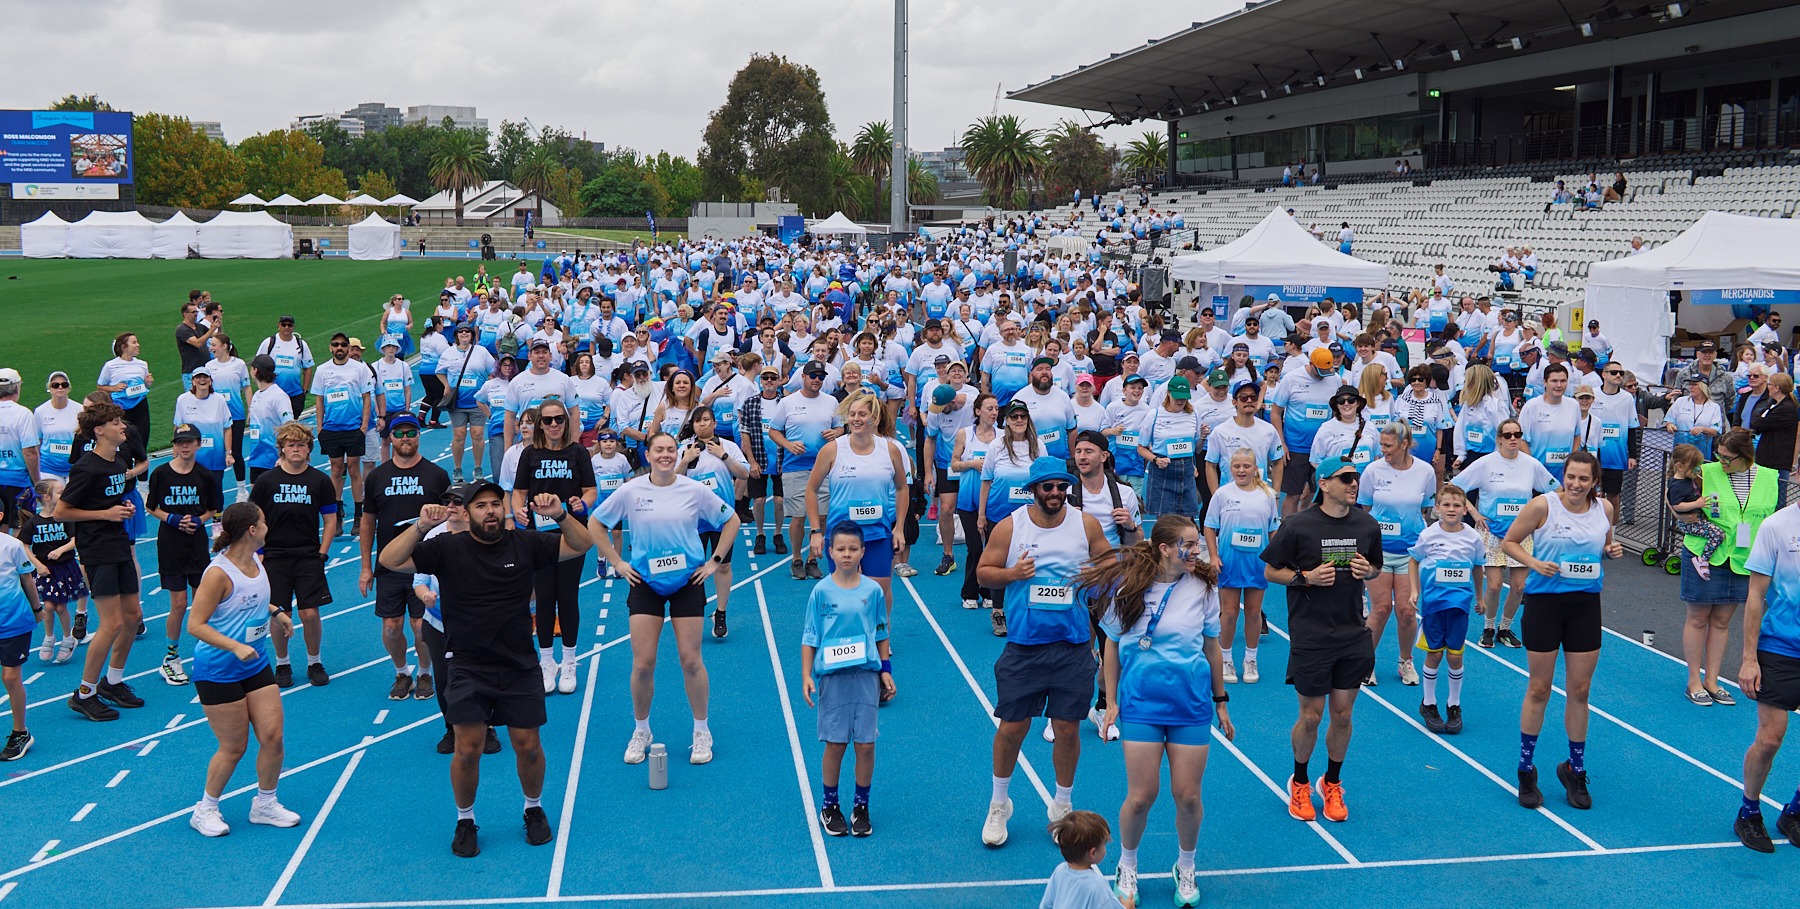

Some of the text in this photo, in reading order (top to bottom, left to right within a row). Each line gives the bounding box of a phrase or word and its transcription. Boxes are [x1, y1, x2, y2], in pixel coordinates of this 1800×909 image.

[1283, 285, 1326, 294] PHOTO BOOTH
[1722, 289, 1775, 298] MERCHANDISE
[541, 460, 567, 469] TEAM
[535, 469, 572, 479] GLAMPA
[391, 476, 418, 486] TEAM
[105, 483, 126, 496] GLAM
[170, 486, 196, 495] TEAM
[280, 484, 307, 494] TEAM
[385, 486, 424, 496] GLAMPA
[164, 495, 200, 505] GLAMPA
[274, 494, 311, 504] GLAMPA
[37, 523, 64, 533] TEAM
[33, 532, 68, 543] GLAMPA
[1240, 535, 1256, 543] 1951
[657, 557, 678, 567] 2105
[1569, 565, 1593, 573] 1584
[1037, 588, 1065, 597] 2205
[832, 646, 856, 656] 1003
